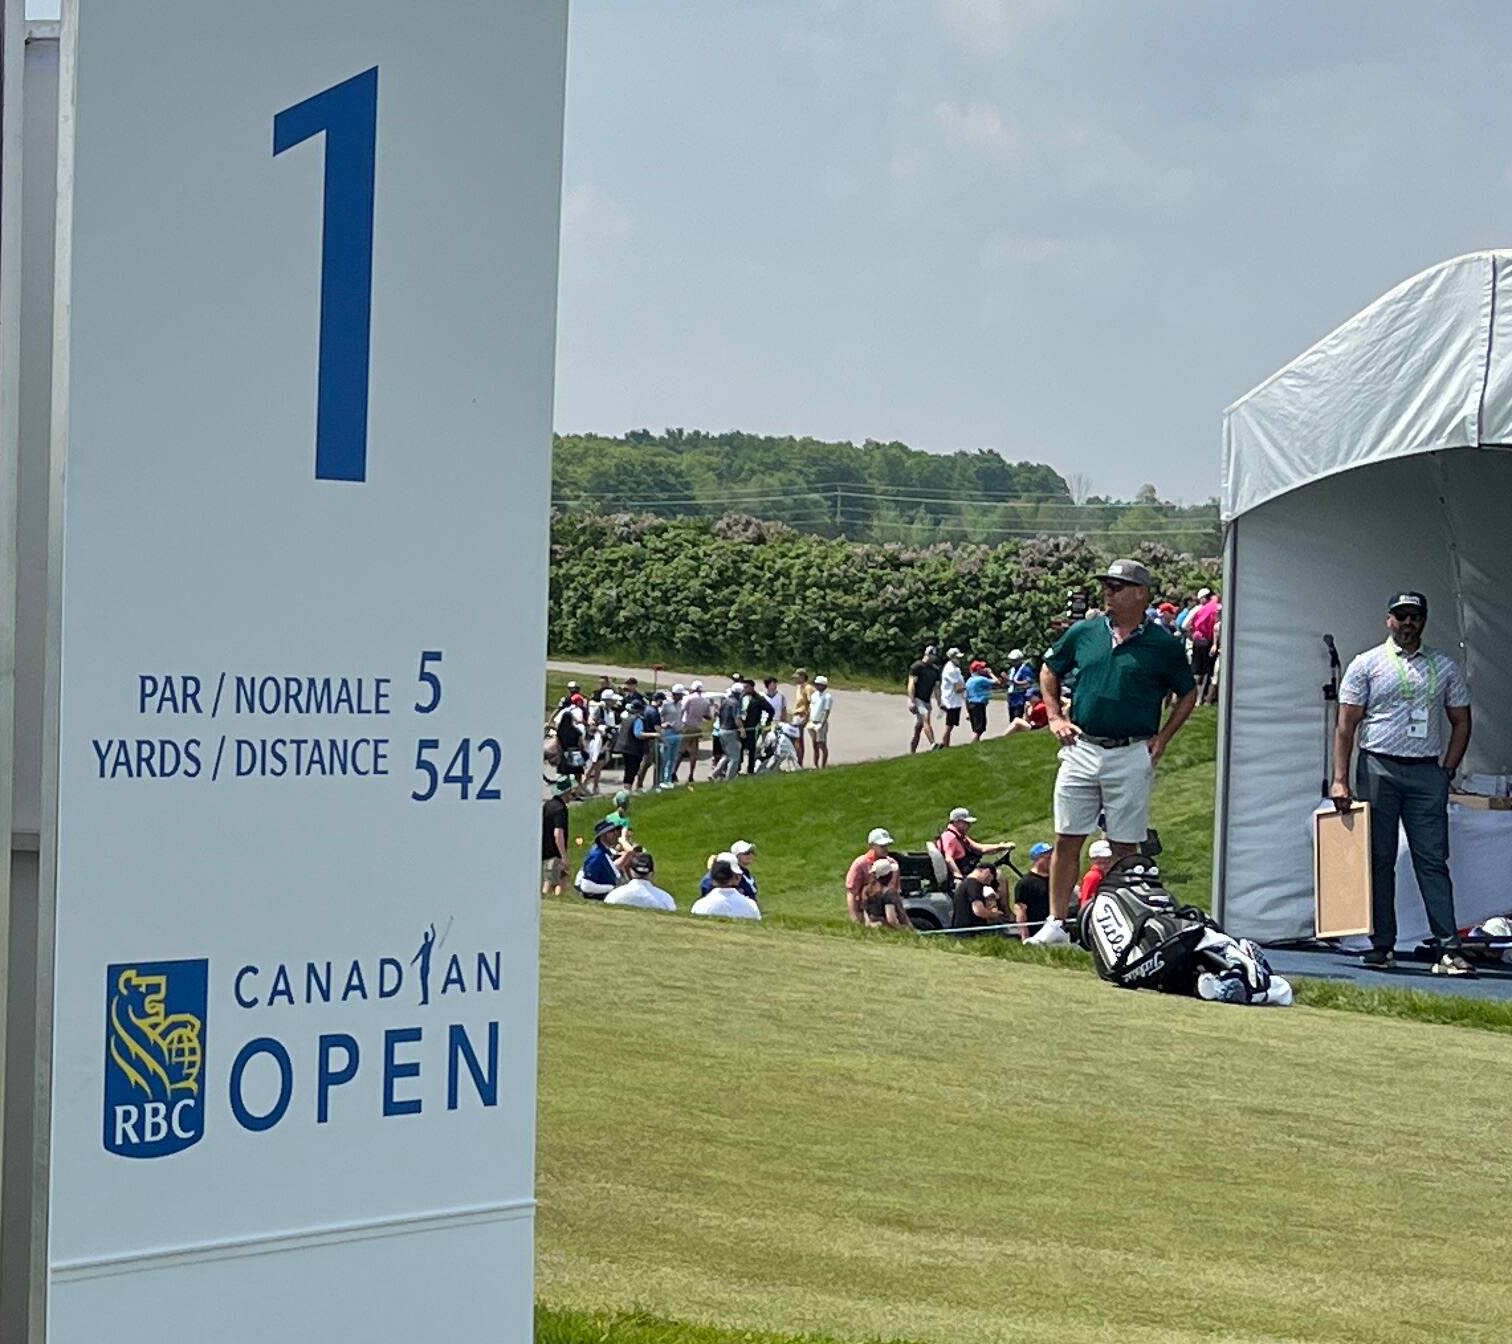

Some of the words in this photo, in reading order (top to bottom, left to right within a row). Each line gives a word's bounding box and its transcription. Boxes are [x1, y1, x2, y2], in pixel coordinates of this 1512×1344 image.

[273, 64, 379, 483] 1
[235, 675, 392, 715] NORMALE
[413, 650, 443, 715] 5
[235, 737, 390, 777] DISTANCE
[410, 737, 503, 802] 542
[1096, 903, 1125, 955] Title
[234, 924, 502, 1009] CANADIAN
[228, 1020, 500, 1133] OPEN
[113, 1098, 197, 1146] RBC
